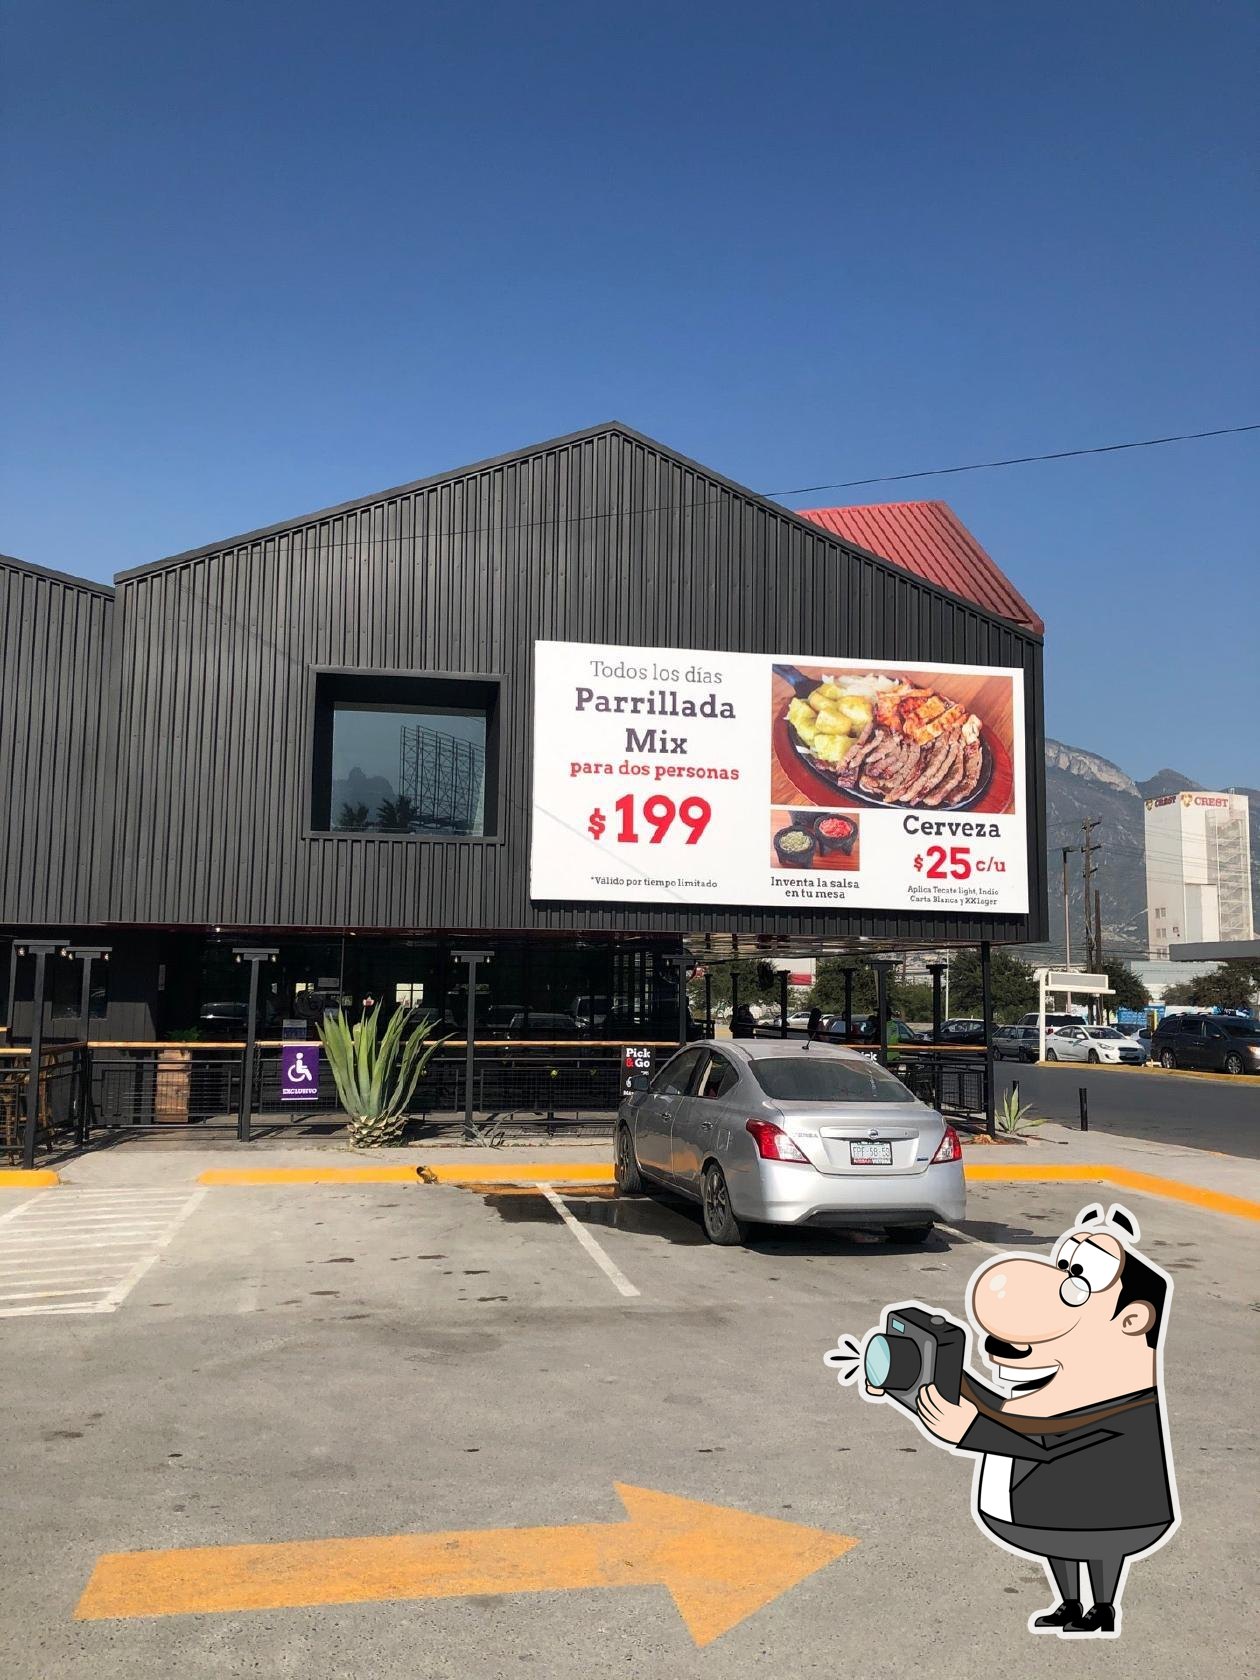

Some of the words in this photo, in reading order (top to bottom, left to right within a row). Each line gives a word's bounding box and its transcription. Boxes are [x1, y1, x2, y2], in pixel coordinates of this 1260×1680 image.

[590, 660, 648, 680] Todos
[653, 663, 680, 682] los
[685, 666, 723, 684] días
[575, 686, 736, 719] Parrillada
[625, 728, 688, 755] Mix
[570, 761, 614, 777] para
[618, 760, 650, 776] dos
[654, 765, 740, 781] personas
[1194, 797, 1228, 808] CREST
[588, 793, 712, 845] $199
[903, 814, 1001, 838] Cerveza
[914, 845, 972, 880] $25
[975, 856, 1006, 873] c/u
[626, 878, 642, 888] por
[643, 877, 676, 888] tiempo
[677, 878, 718, 888] limitado
[770, 876, 815, 887] Inventa
[816, 877, 828, 888] la
[829, 878, 860, 889] salsa
[785, 889, 799, 898] en
[801, 888, 813, 898] tu
[815, 890, 846, 899] mesa
[625, 1047, 651, 1058] Pick
